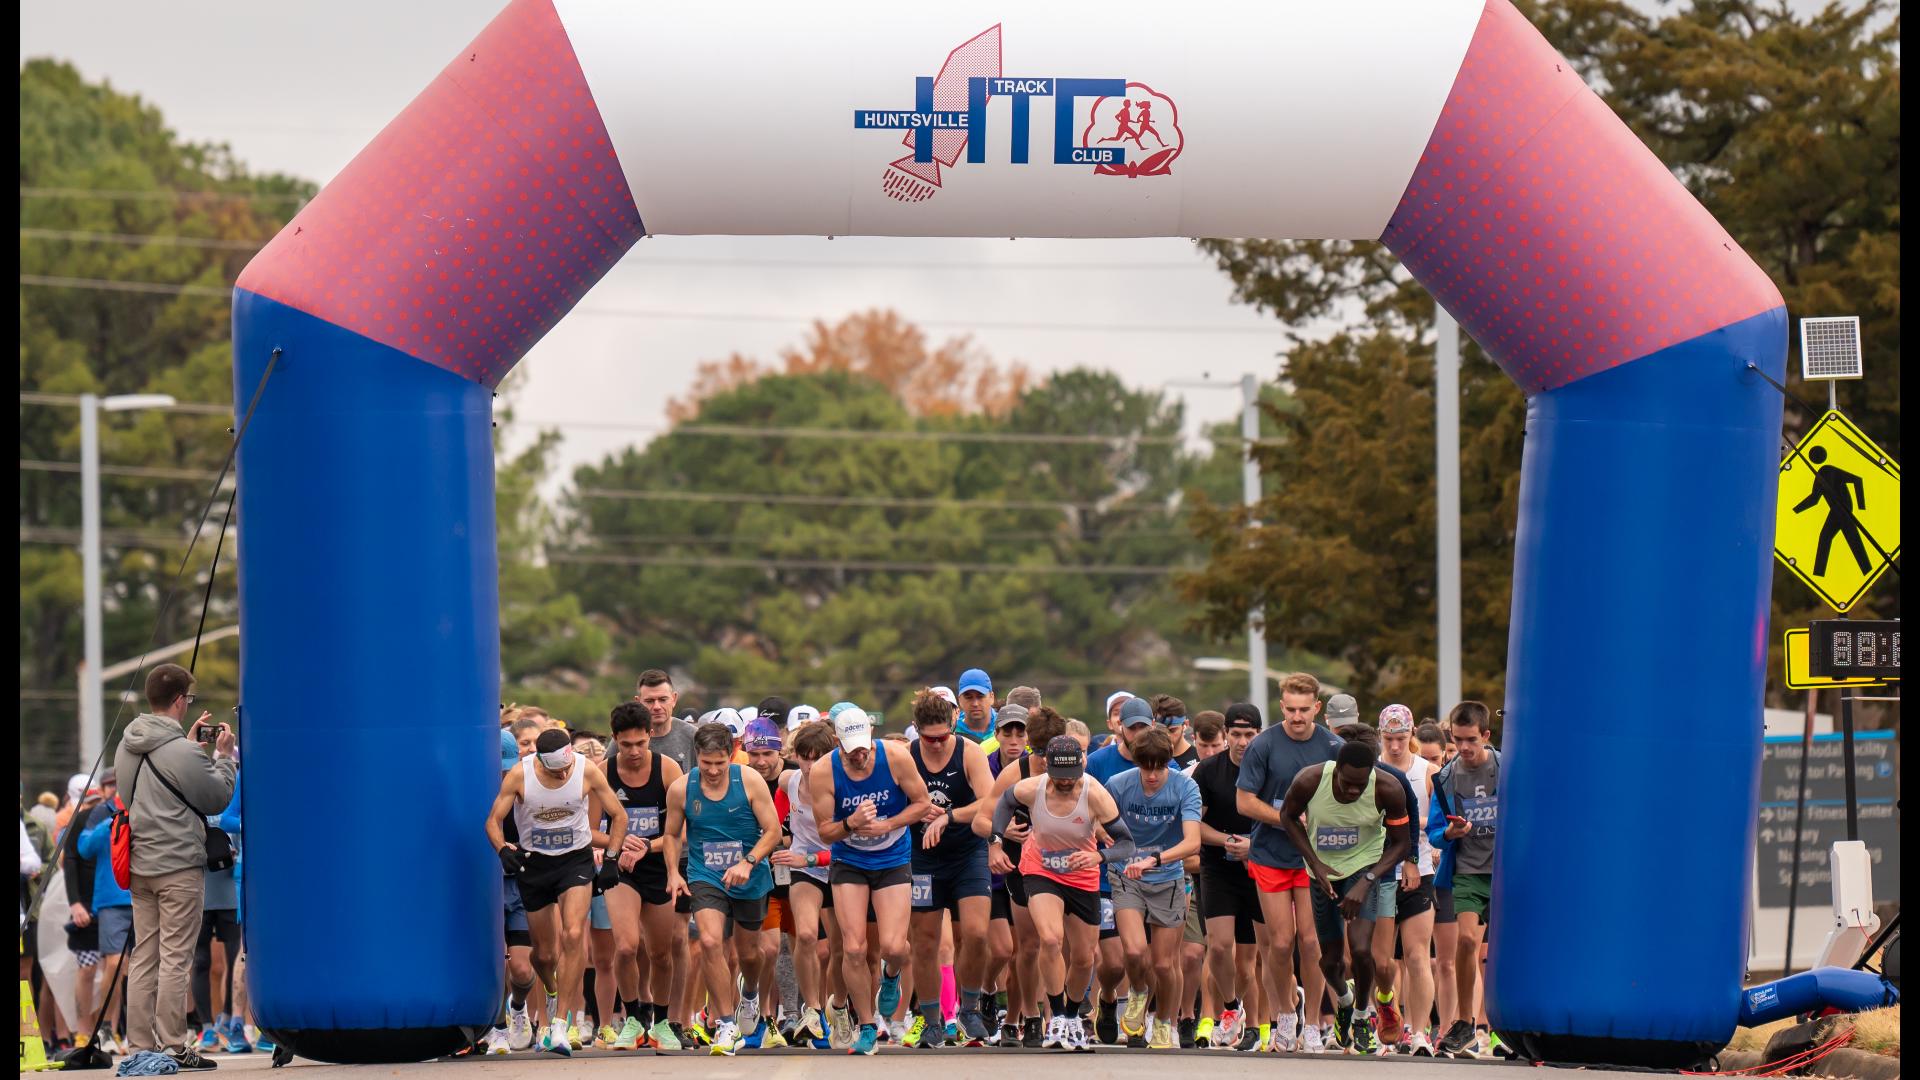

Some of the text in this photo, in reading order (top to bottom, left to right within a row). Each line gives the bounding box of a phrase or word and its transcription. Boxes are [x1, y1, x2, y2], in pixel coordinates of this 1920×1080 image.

[994, 79, 1048, 94] TRACK
[864, 112, 969, 127] HUNTSVILLE
[1072, 149, 1113, 163] CLUB
[627, 816, 659, 832] 796
[533, 834, 573, 846] 2195
[1318, 834, 1358, 846] 2956
[704, 850, 743, 866] 2574
[1042, 856, 1069, 869] 268
